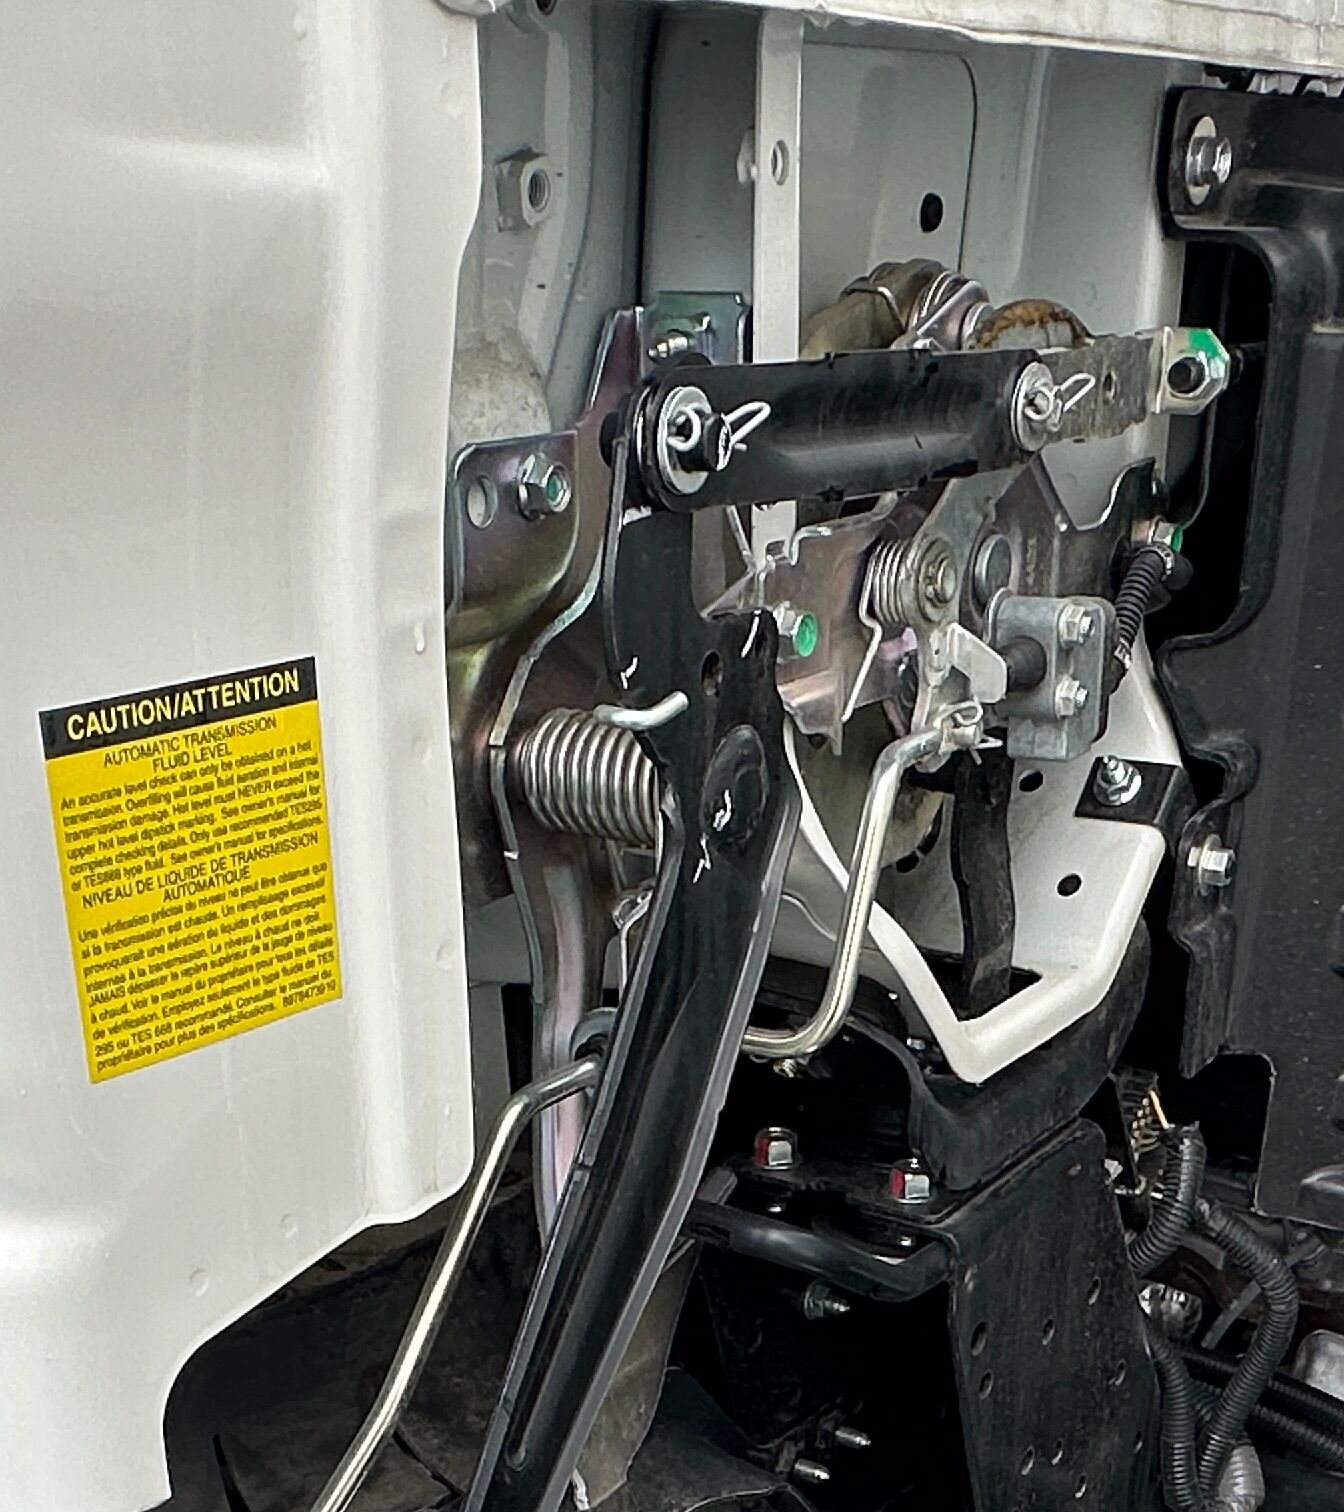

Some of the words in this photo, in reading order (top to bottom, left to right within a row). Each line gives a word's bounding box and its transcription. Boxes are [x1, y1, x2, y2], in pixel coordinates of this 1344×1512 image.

[64, 668, 299, 741] CAUTION/ATTENTION
[102, 735, 179, 767] AUTOMATIC
[183, 714, 276, 748] TRANSMISSION
[152, 751, 190, 773] FLUID
[192, 741, 232, 763] LEVEL
[81, 882, 133, 909] NIVEAU
[135, 876, 153, 894] DE
[156, 861, 206, 888] LIQUIDE
[209, 856, 226, 873] DE
[230, 830, 318, 867] TRANSMISSION
[162, 865, 250, 902] AUTOMATIQUE
